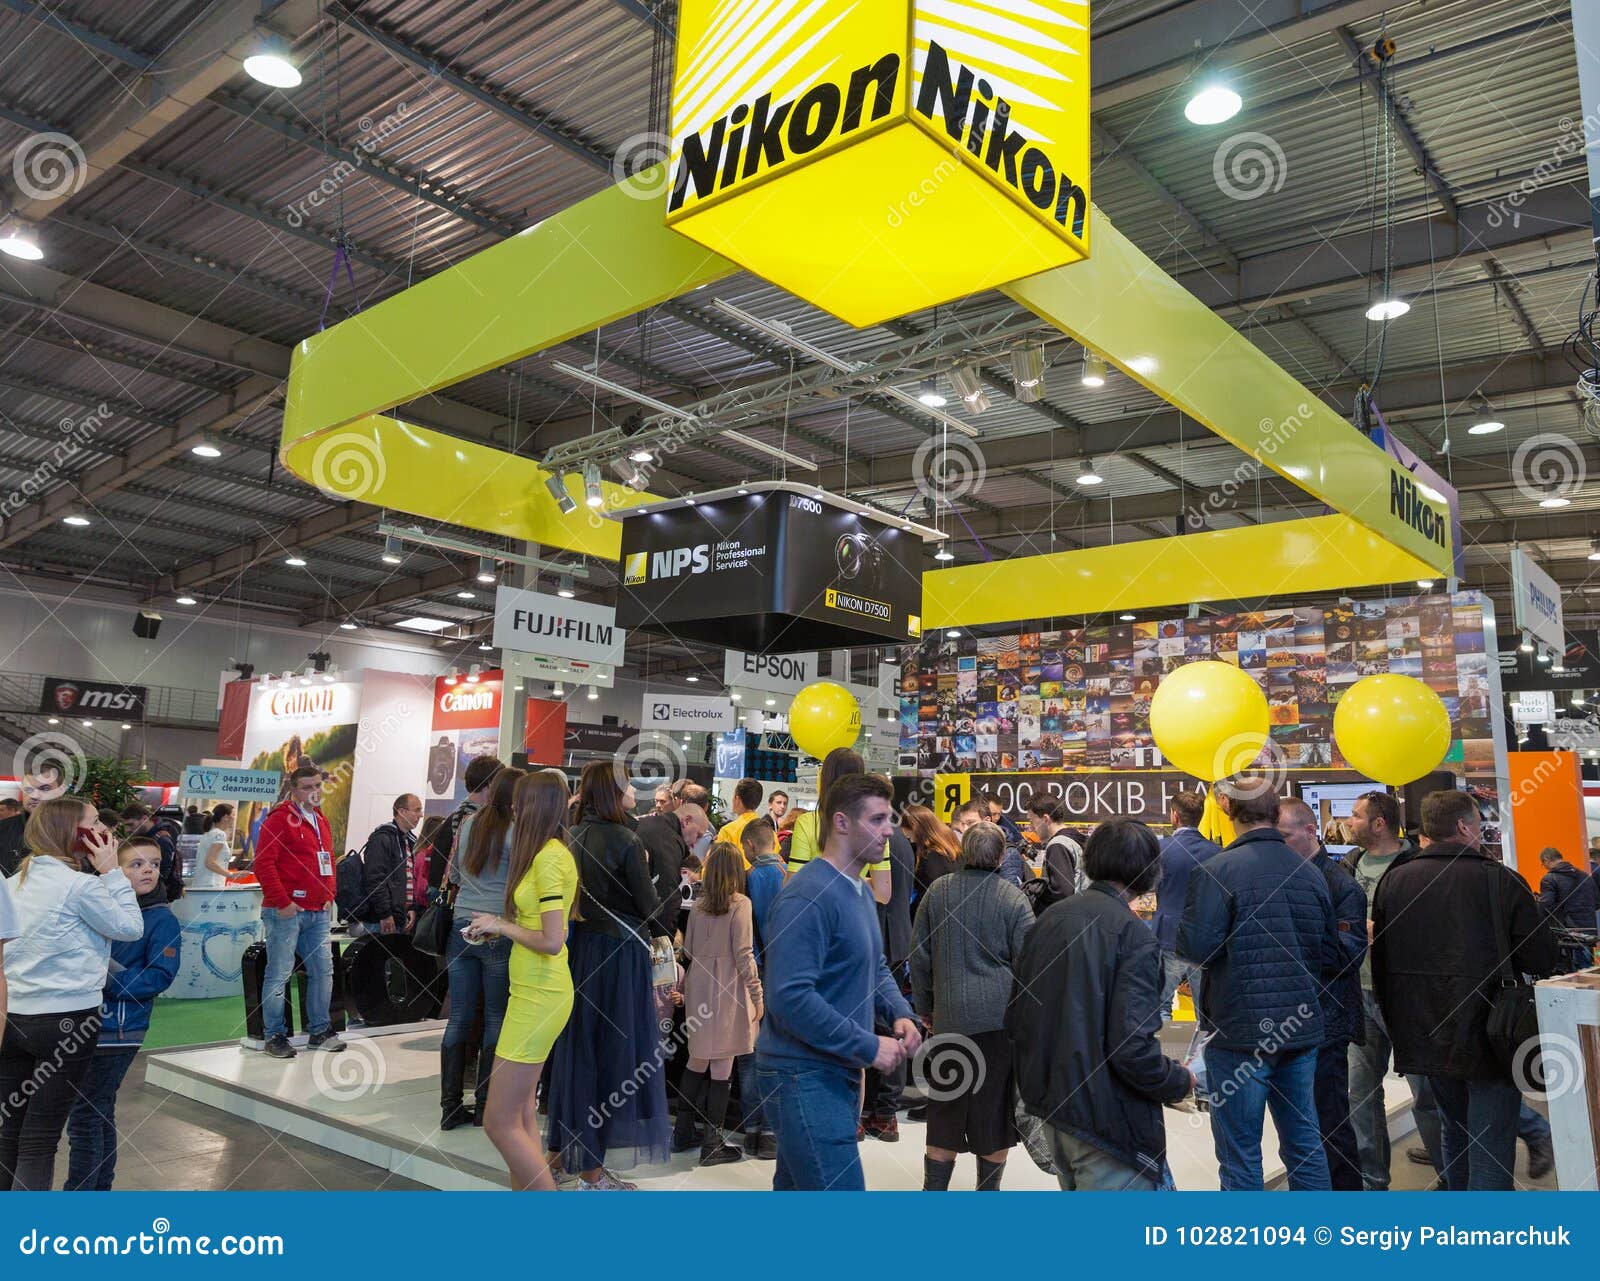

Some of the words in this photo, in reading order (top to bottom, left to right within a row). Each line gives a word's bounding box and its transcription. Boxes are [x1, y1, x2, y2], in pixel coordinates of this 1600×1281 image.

[669, 52, 900, 213] Nikon
[916, 39, 1087, 240] Nikon
[790, 495, 822, 514] D7500
[1391, 468, 1445, 548] Nikon
[716, 546, 766, 561] Professional
[717, 541, 740, 550] Nikon
[652, 544, 709, 579] NPS
[716, 559, 748, 571] Services
[625, 576, 645, 584] Nikon
[837, 595, 863, 611] NIKON
[865, 602, 889, 618] D7500
[513, 609, 612, 646] FUJIFILM
[743, 652, 805, 682] EPSON
[80, 690, 137, 710] msi
[271, 687, 333, 715] Canon
[440, 692, 493, 712] Canon
[673, 707, 723, 719] Electrolux
[222, 783, 275, 794] clearwater.ua
[223, 775, 238, 783] 044
[240, 776, 253, 784] 391
[255, 777, 265, 785] 30
[944, 784, 960, 812] Я
